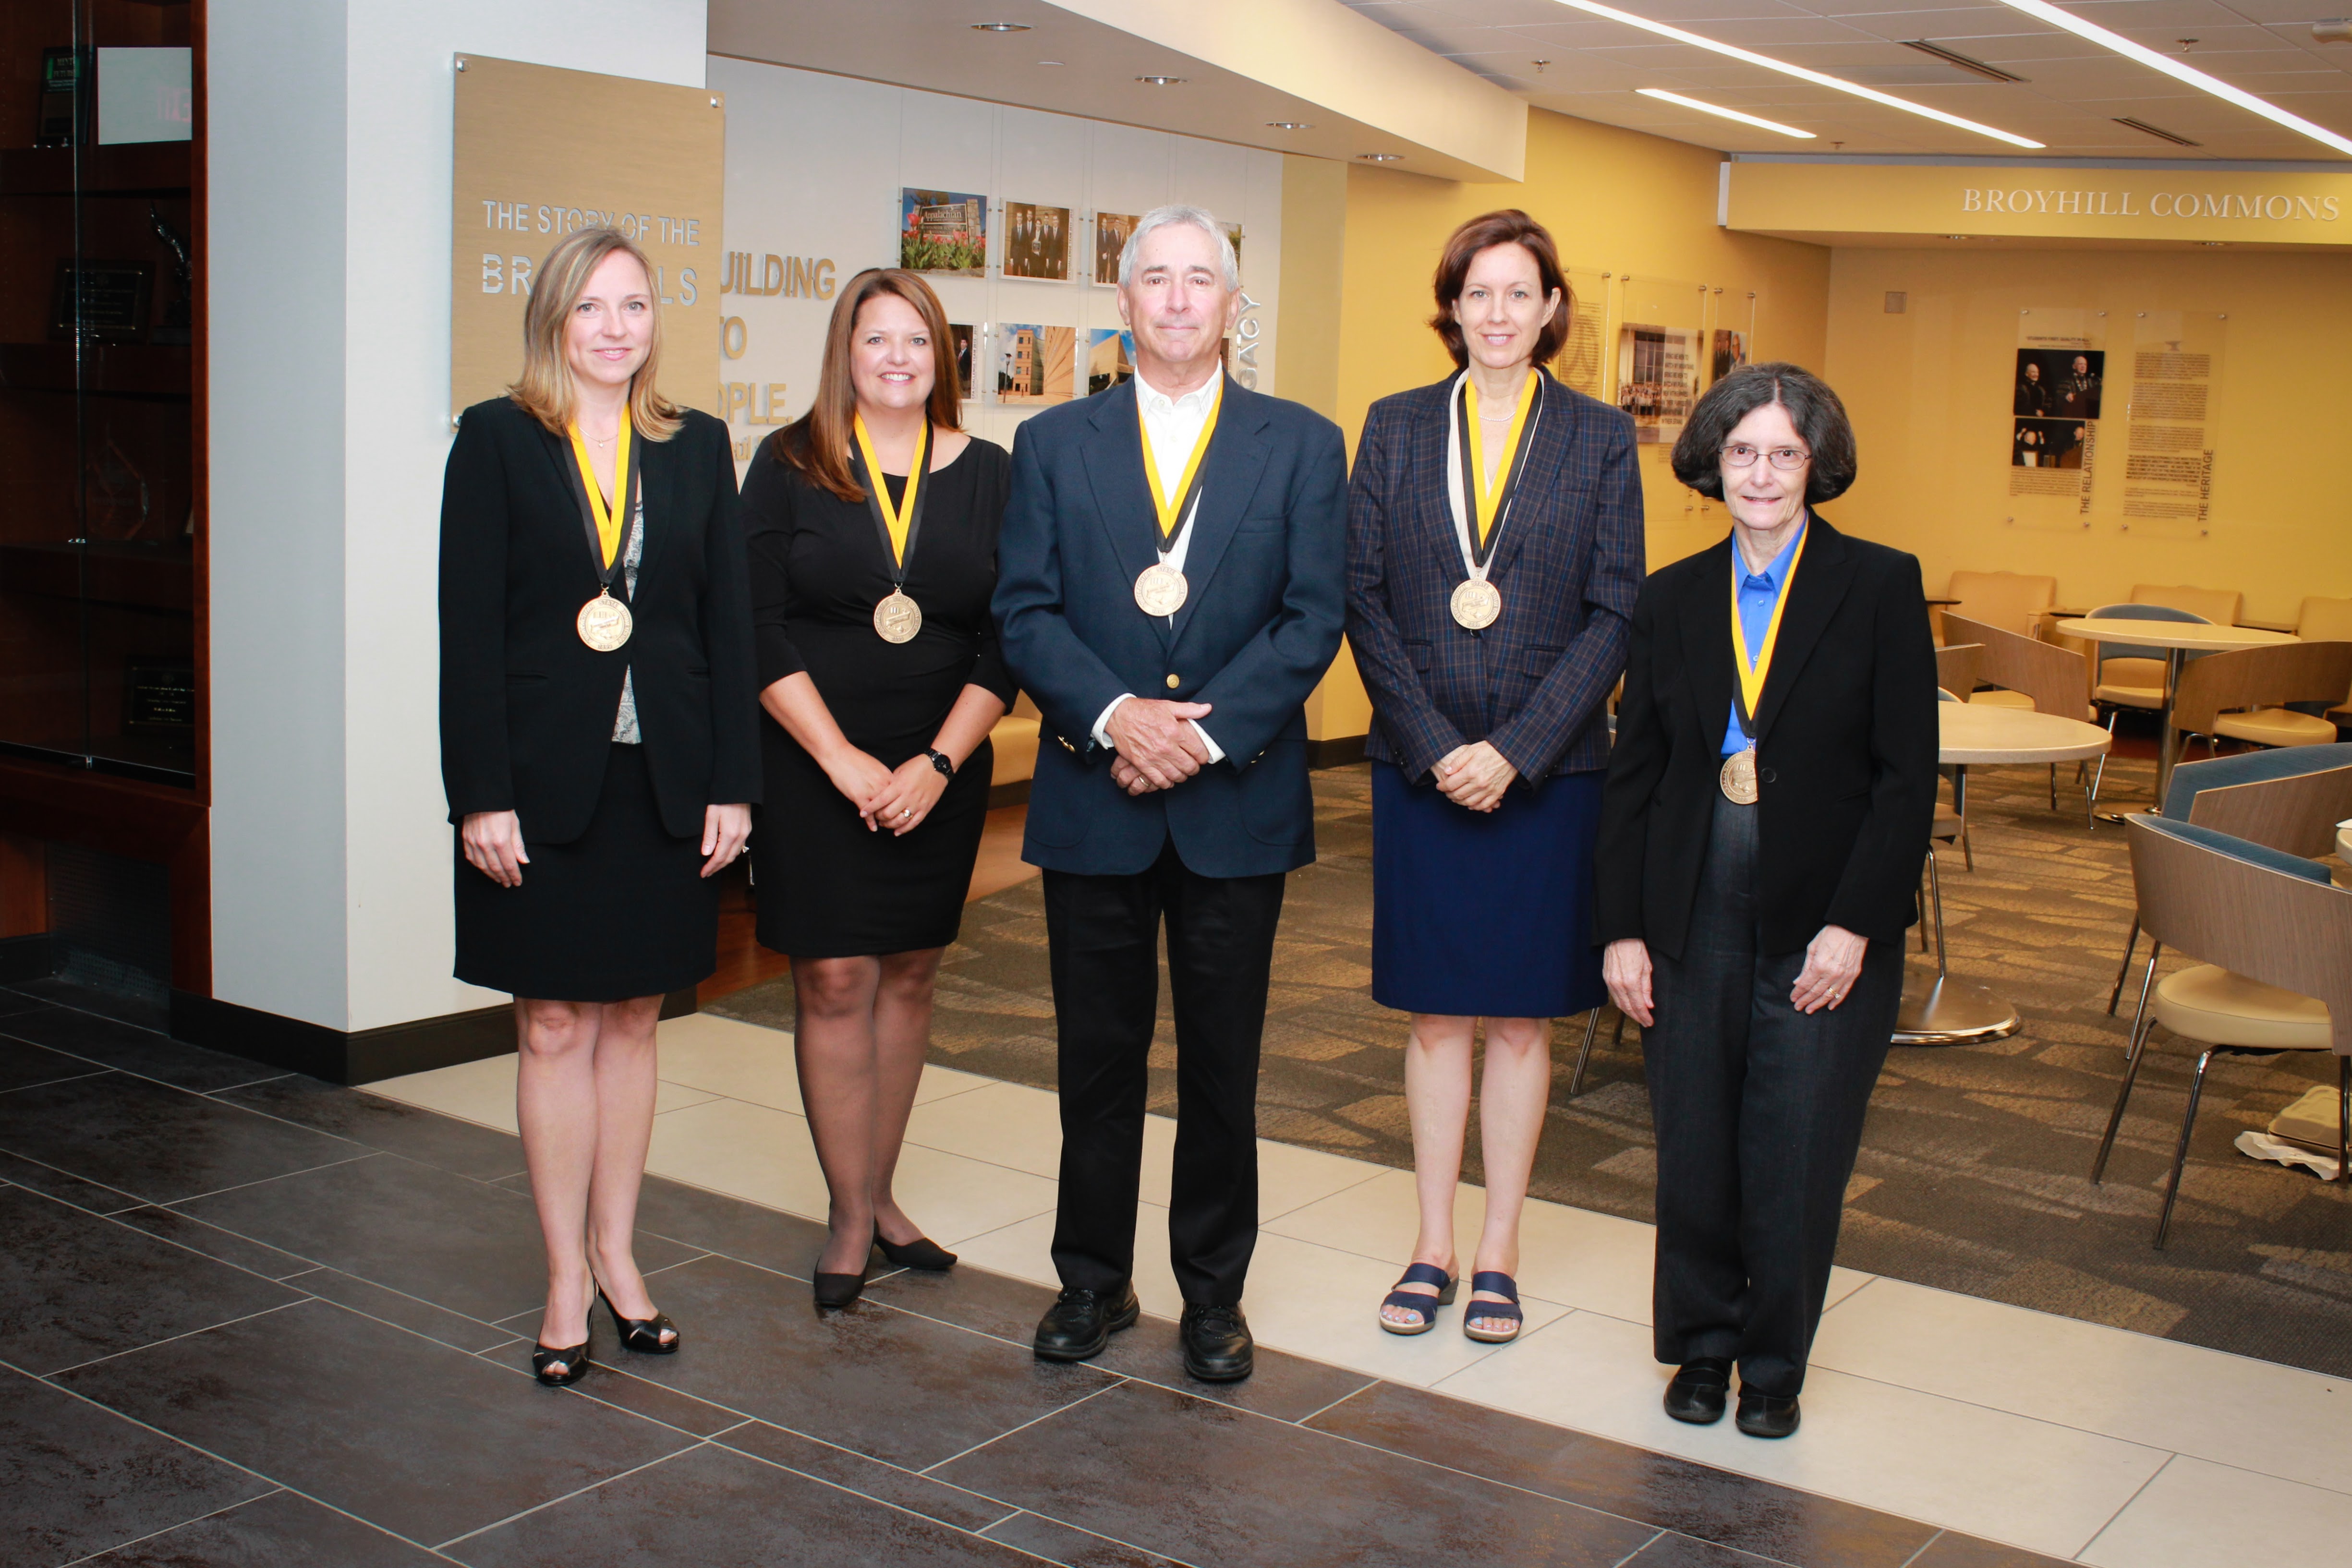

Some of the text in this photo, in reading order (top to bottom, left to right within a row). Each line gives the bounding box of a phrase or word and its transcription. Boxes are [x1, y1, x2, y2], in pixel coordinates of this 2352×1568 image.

[924, 210, 962, 221] Appalachian
[1962, 188, 2340, 221] BROYHILL COMMONS
[483, 200, 700, 246] THE STORY OF THE
[2080, 421, 2096, 515] THE RELATIONSHIP
[2197, 449, 2213, 522] THE HERITAGE
[1471, 581, 1490, 590] STATE
[598, 600, 619, 608] STATE
